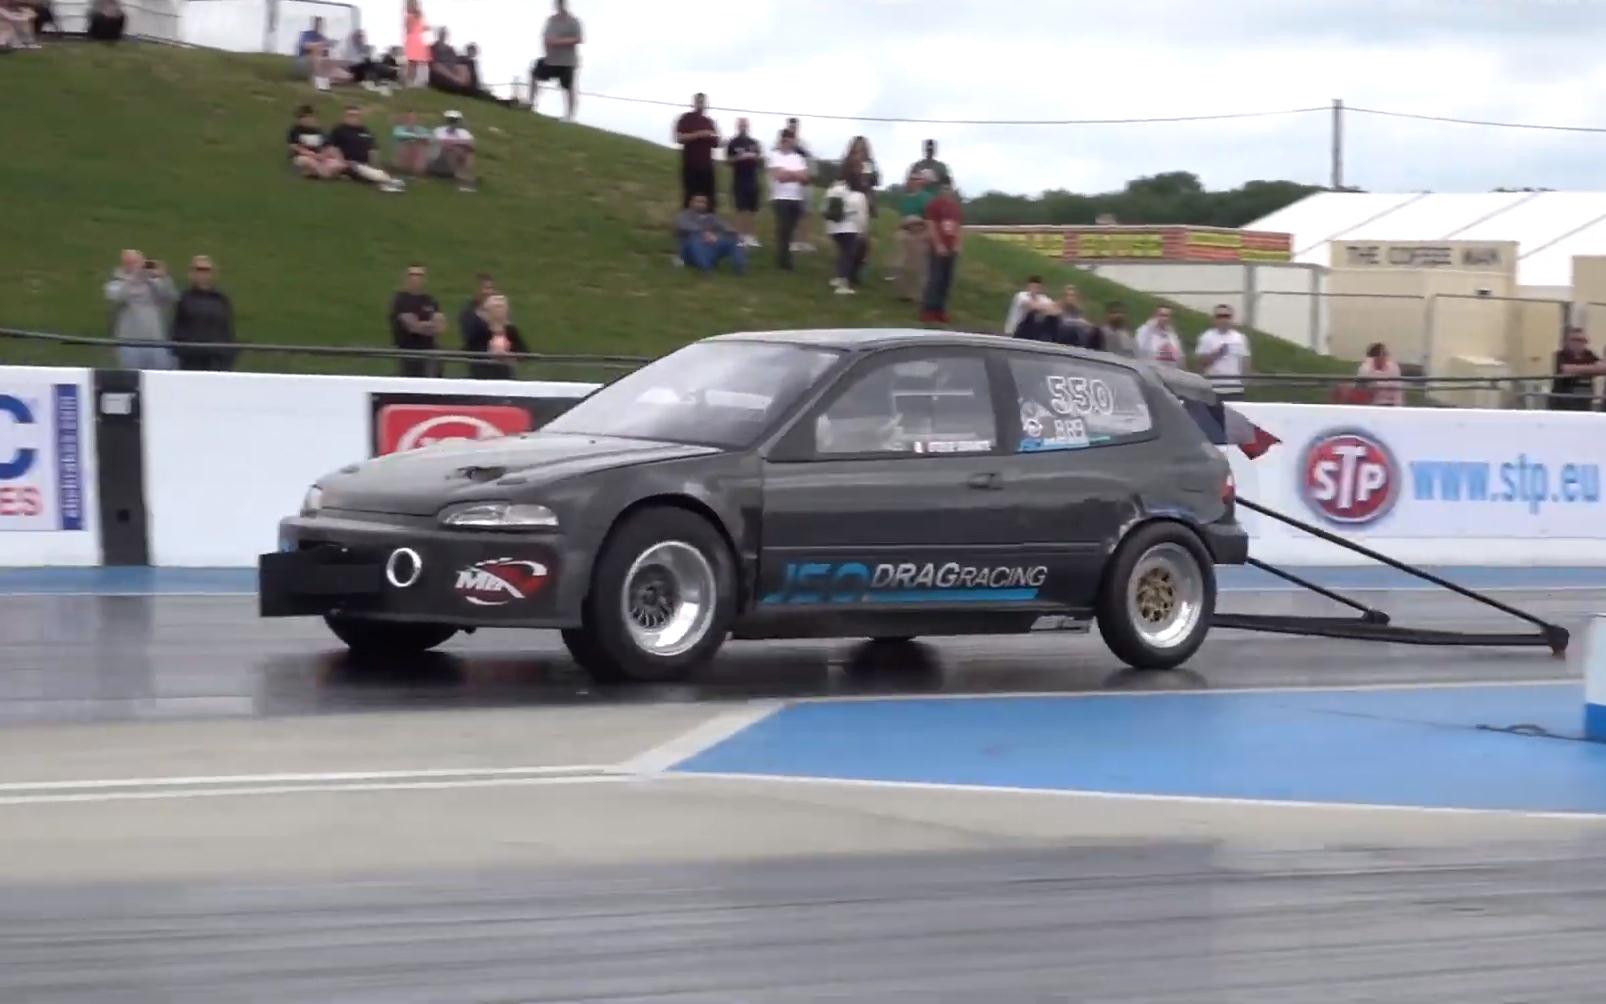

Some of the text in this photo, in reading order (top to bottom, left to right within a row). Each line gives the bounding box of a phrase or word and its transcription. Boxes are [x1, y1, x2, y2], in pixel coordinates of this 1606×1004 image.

[1046, 375, 1114, 416] 550
[1313, 446, 1387, 509] STP
[1409, 453, 1600, 515] www.stp.eu
